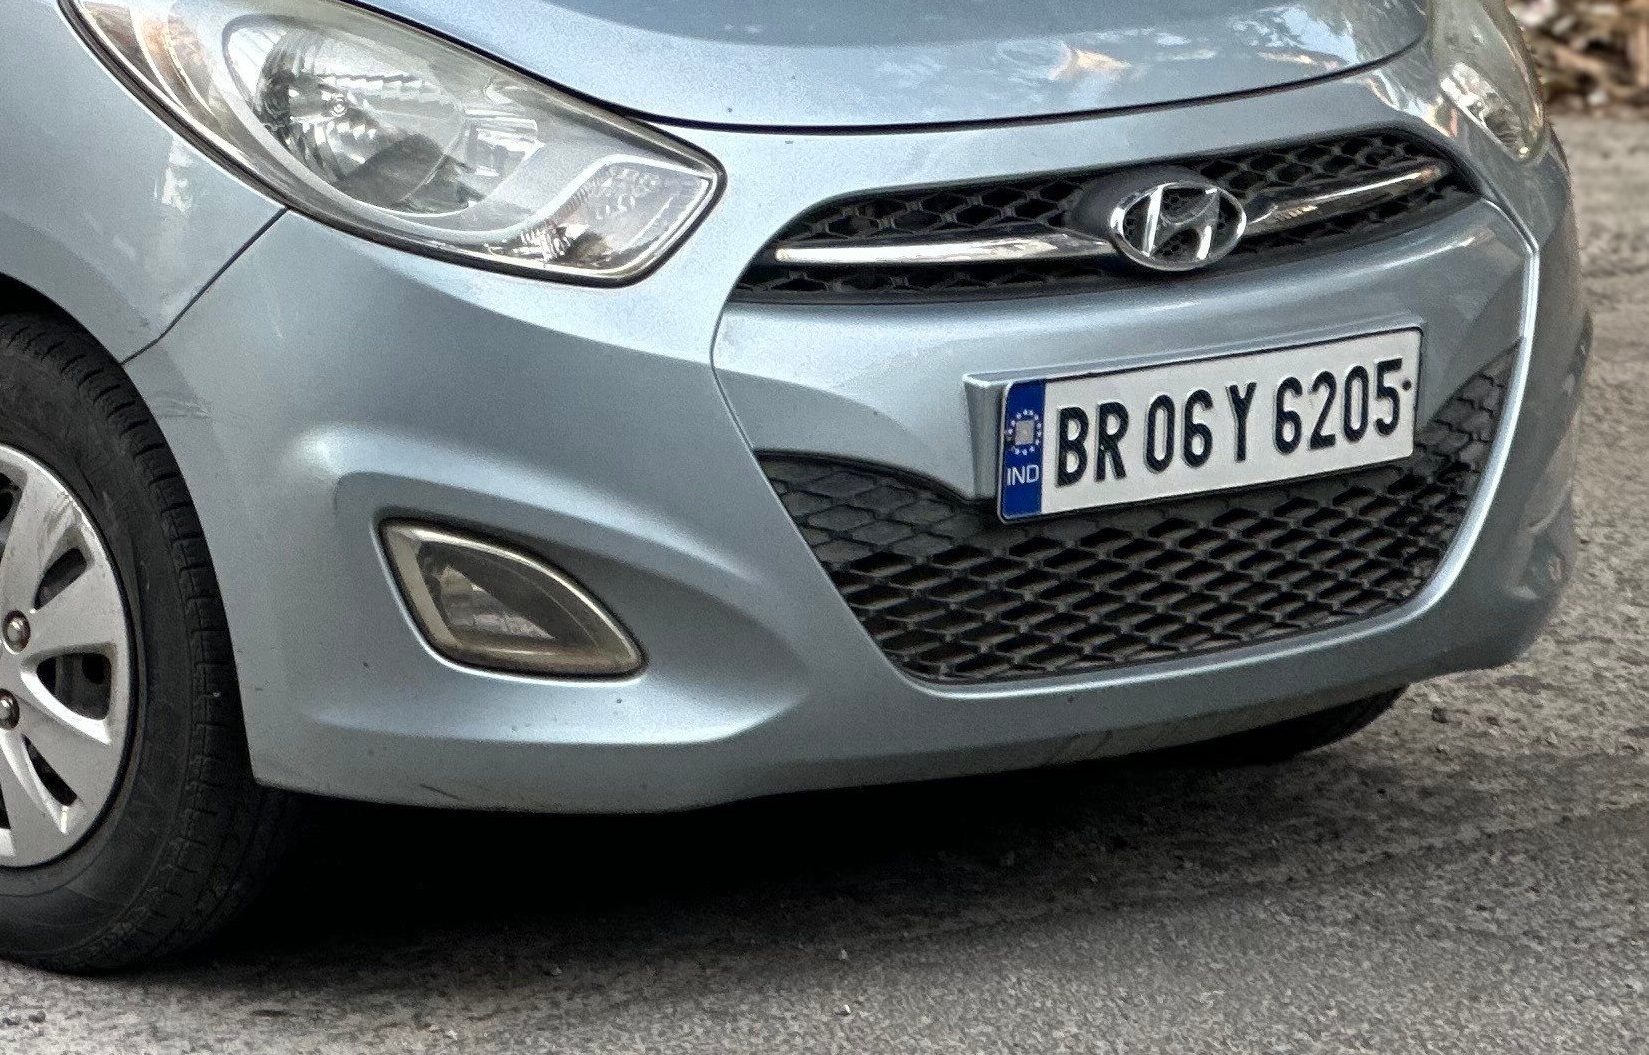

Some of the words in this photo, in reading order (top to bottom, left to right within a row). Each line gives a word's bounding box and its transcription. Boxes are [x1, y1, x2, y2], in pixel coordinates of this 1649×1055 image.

[1055, 401, 1129, 487] BR
[1145, 388, 1214, 473] 06
[1225, 381, 1257, 463] Y
[1273, 357, 1404, 455] 6205
[1006, 464, 1040, 486] IND
